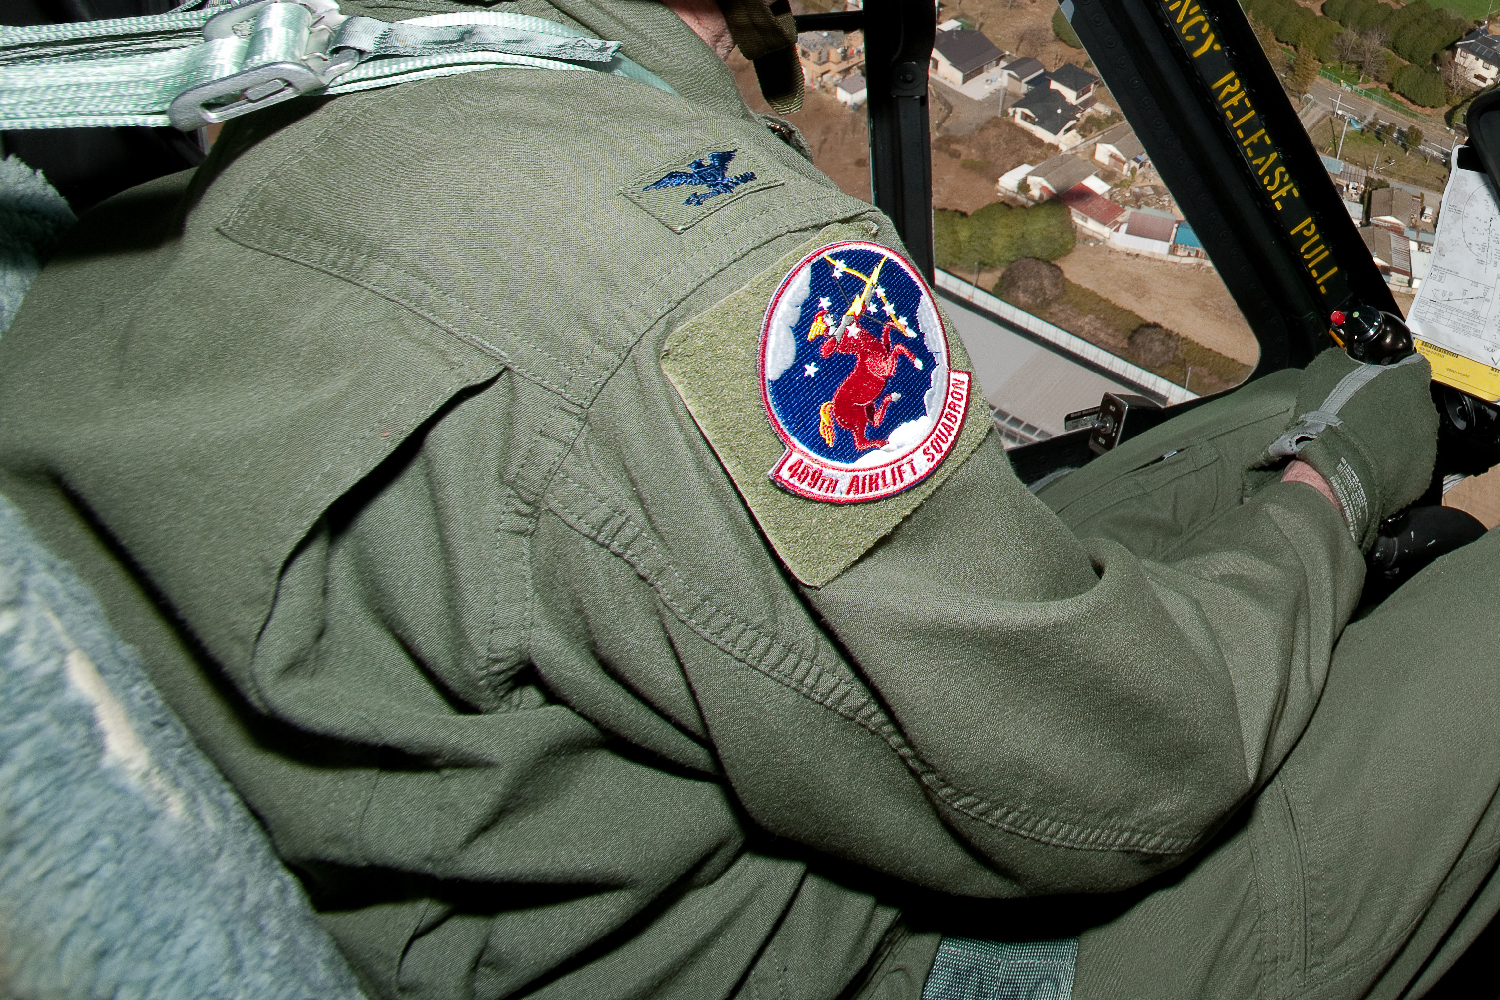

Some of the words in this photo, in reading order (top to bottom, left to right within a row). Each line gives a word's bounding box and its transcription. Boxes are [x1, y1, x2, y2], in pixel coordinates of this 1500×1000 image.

[1211, 70, 1300, 211] RELEASE
[1290, 216, 1339, 294] PULL
[845, 457, 918, 496] AIRLIFT
